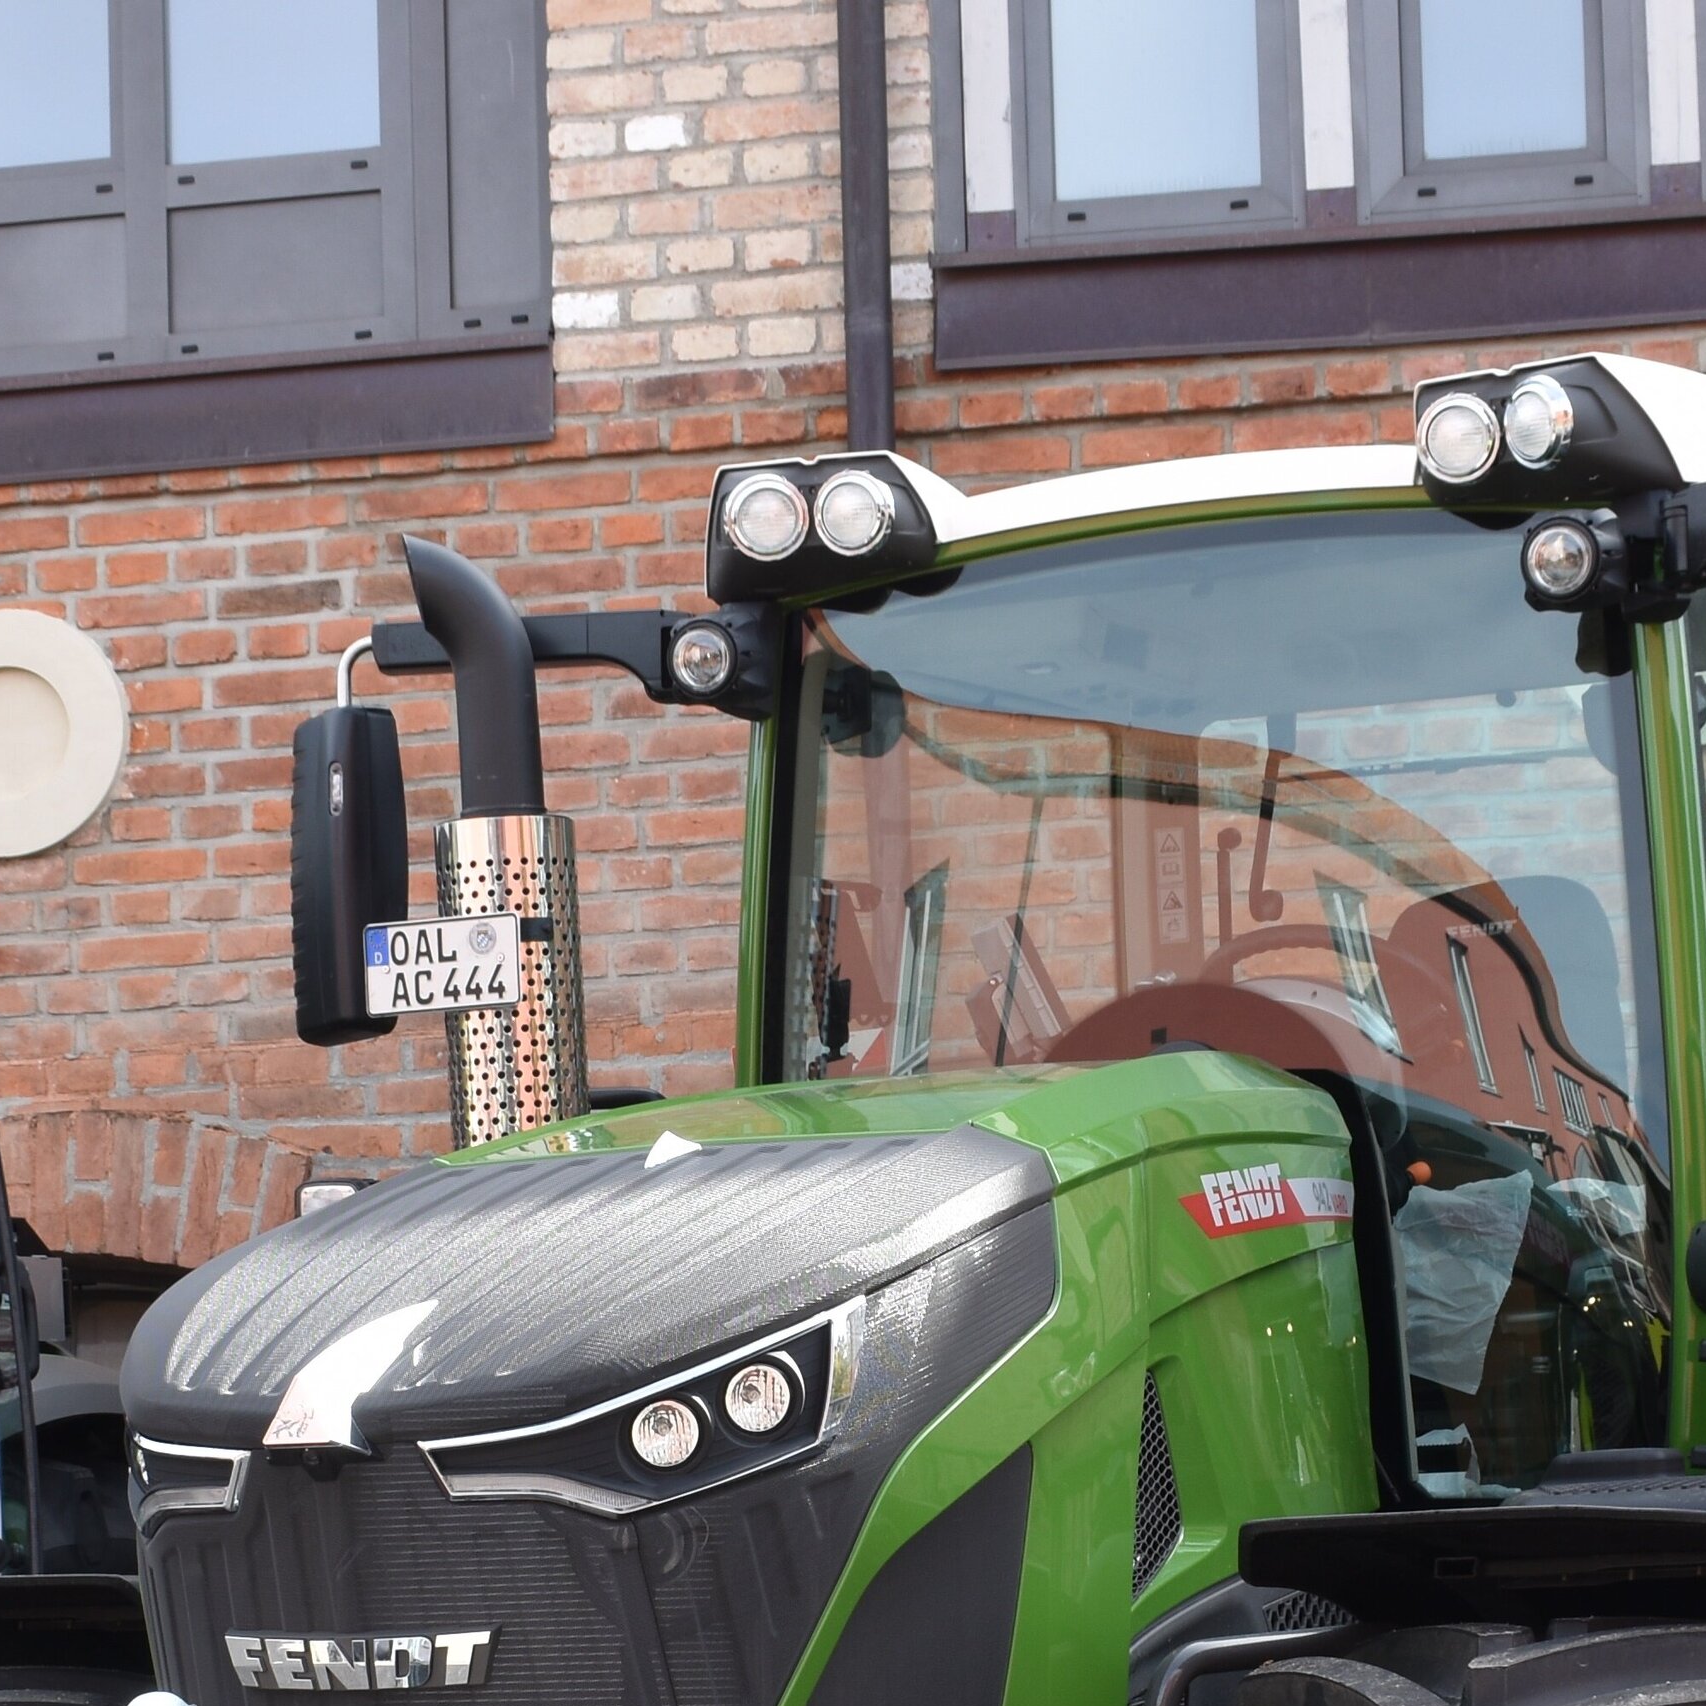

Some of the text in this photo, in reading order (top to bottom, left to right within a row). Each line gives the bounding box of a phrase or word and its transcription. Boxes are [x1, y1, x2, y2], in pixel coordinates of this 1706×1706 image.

[390, 927, 457, 966] OAL
[1446, 919, 1517, 939] FENDT
[374, 952, 383, 965] D
[392, 963, 506, 1008] AC 444
[1200, 1162, 1286, 1228] FENDT
[224, 1630, 492, 1690] FENDT
